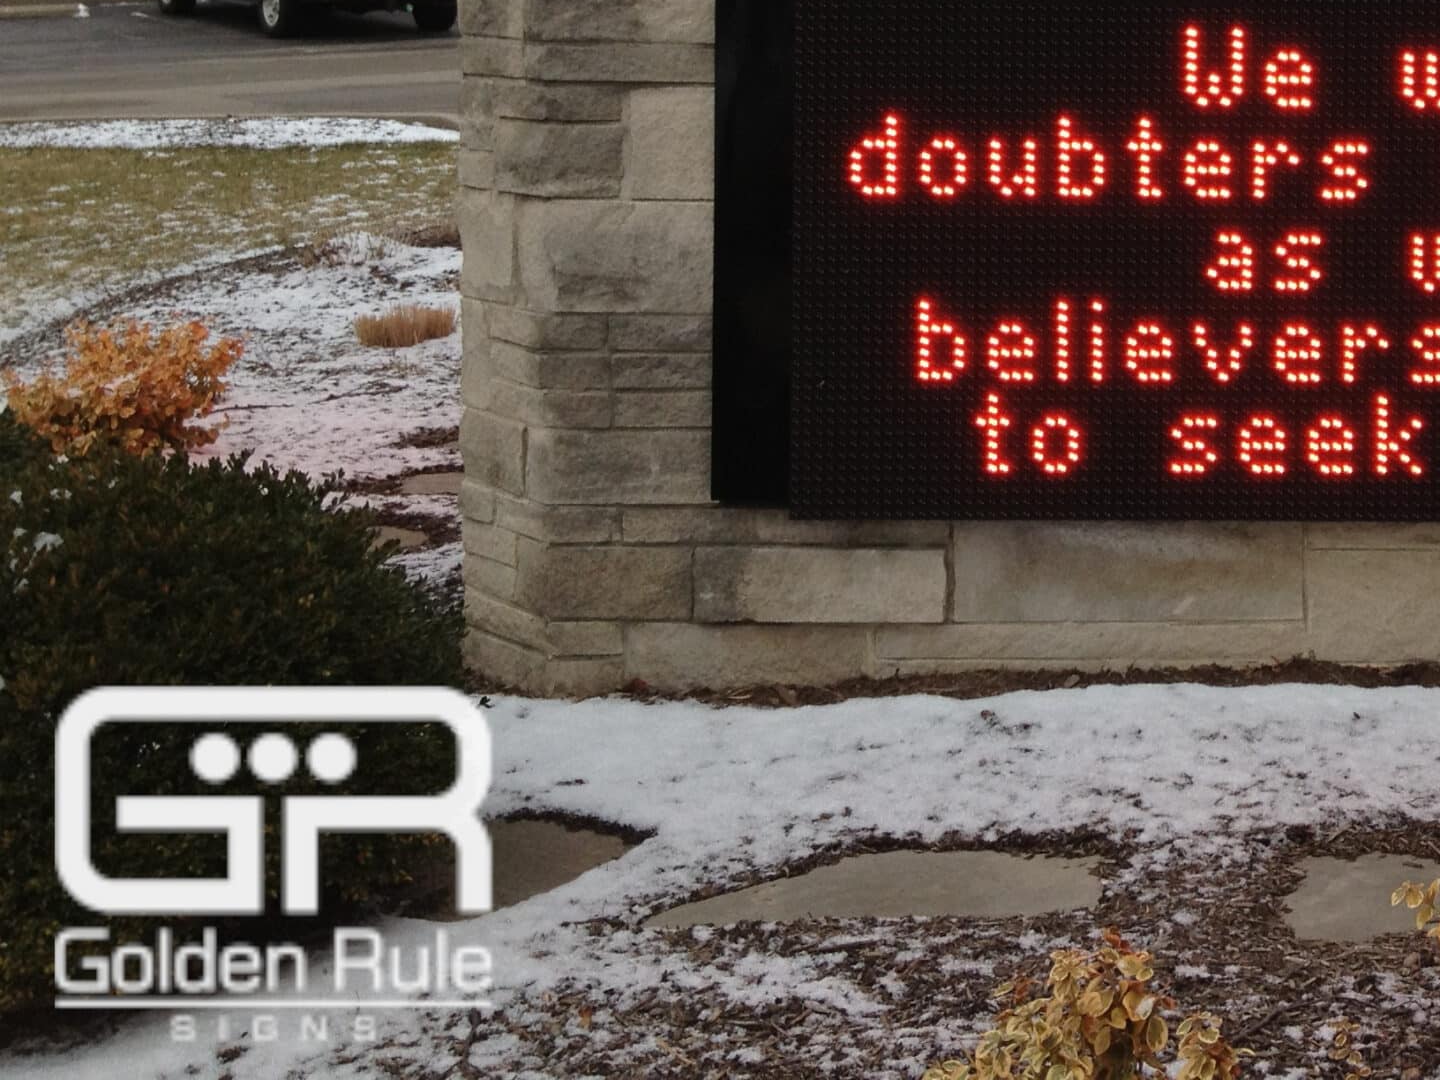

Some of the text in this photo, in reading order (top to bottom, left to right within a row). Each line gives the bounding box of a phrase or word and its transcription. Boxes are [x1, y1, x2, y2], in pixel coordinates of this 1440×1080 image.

[1182, 23, 1314, 110] We
[848, 113, 1370, 201] doubters
[1205, 231, 1323, 293] as
[973, 391, 1081, 475] to
[1169, 393, 1424, 476] seek
